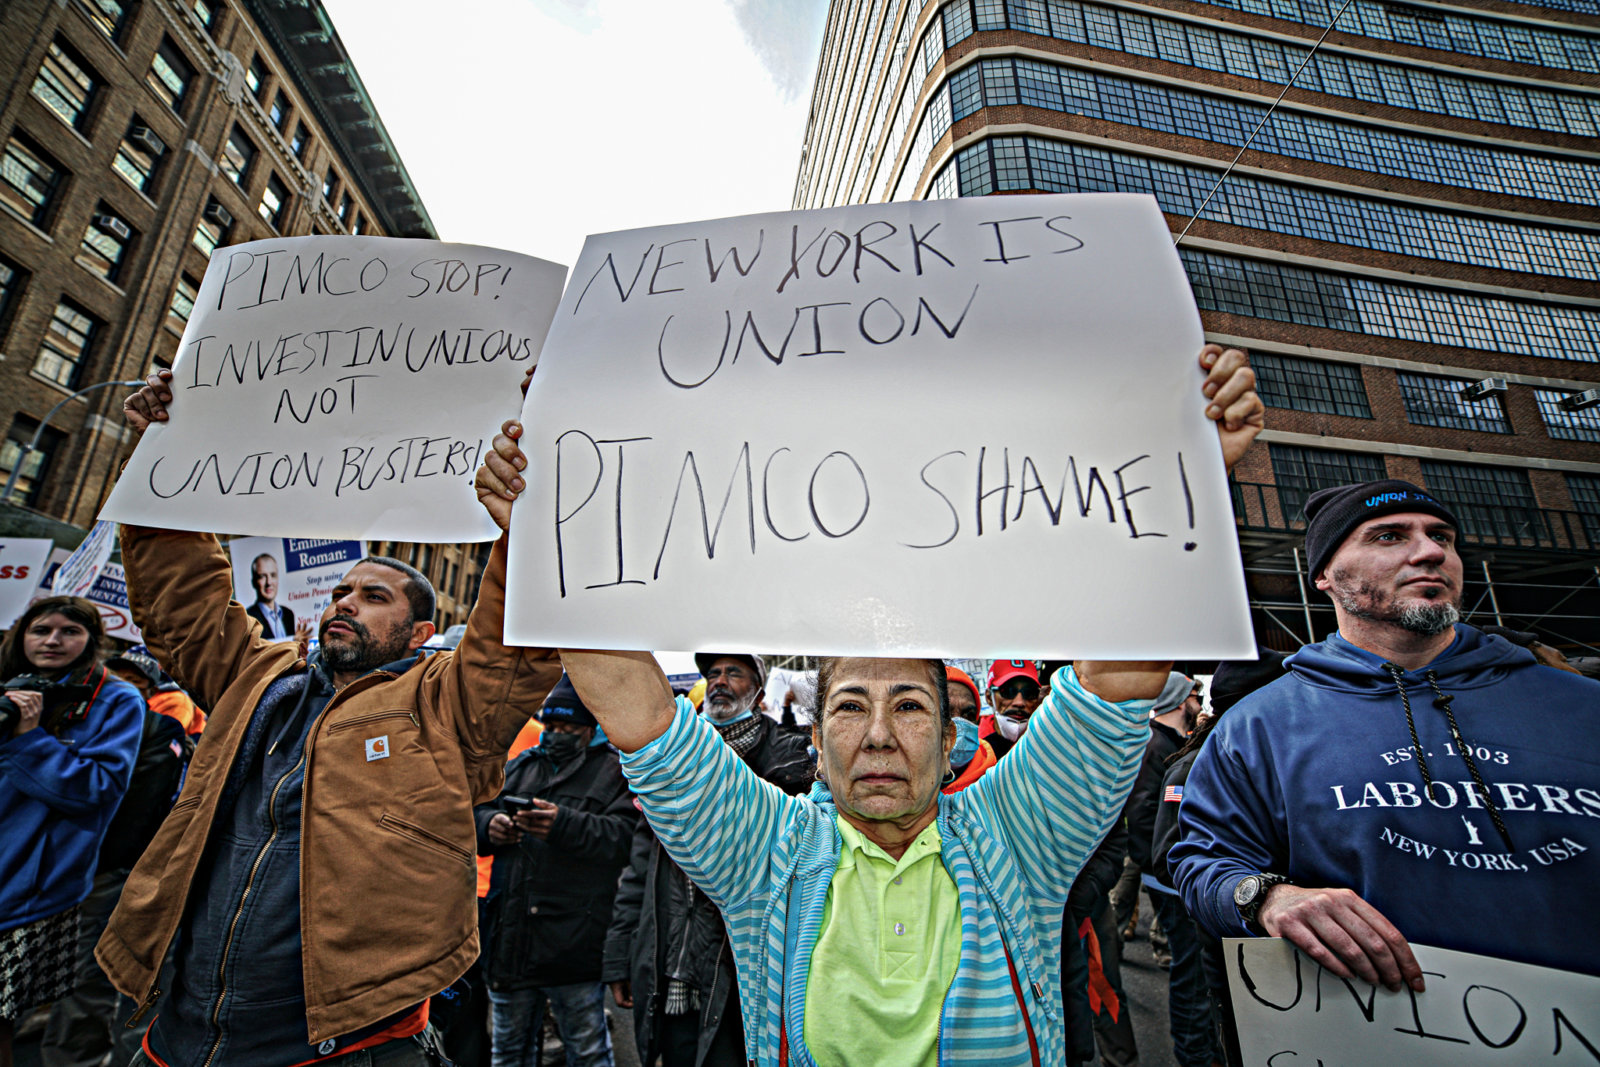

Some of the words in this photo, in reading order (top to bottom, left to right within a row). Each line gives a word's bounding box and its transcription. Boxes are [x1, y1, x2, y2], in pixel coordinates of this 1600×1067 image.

[217, 250, 388, 311] PIMCO
[407, 259, 512, 300] STOP!
[574, 229, 764, 315] NEW
[776, 221, 955, 294] YORK
[978, 215, 1084, 264] IS
[187, 330, 342, 389] INVEST
[344, 323, 402, 367] IN
[405, 329, 531, 373] UNIONS
[658, 284, 979, 389] UNION
[274, 374, 380, 424] NOT
[149, 452, 323, 498] UNION
[335, 436, 483, 497] BUSTERS!
[555, 429, 871, 598] PIMCO
[898, 446, 1198, 551] SHAME!
[1366, 491, 1407, 506] UNION
[299, 549, 347, 568] Roman:
[306, 576, 322, 586] Stop
[288, 590, 310, 601] Union
[1330, 780, 1600, 819] LABORERS
[1379, 826, 1437, 860] NEW
[1443, 849, 1529, 872] YORK,
[1528, 837, 1588, 866] USA
